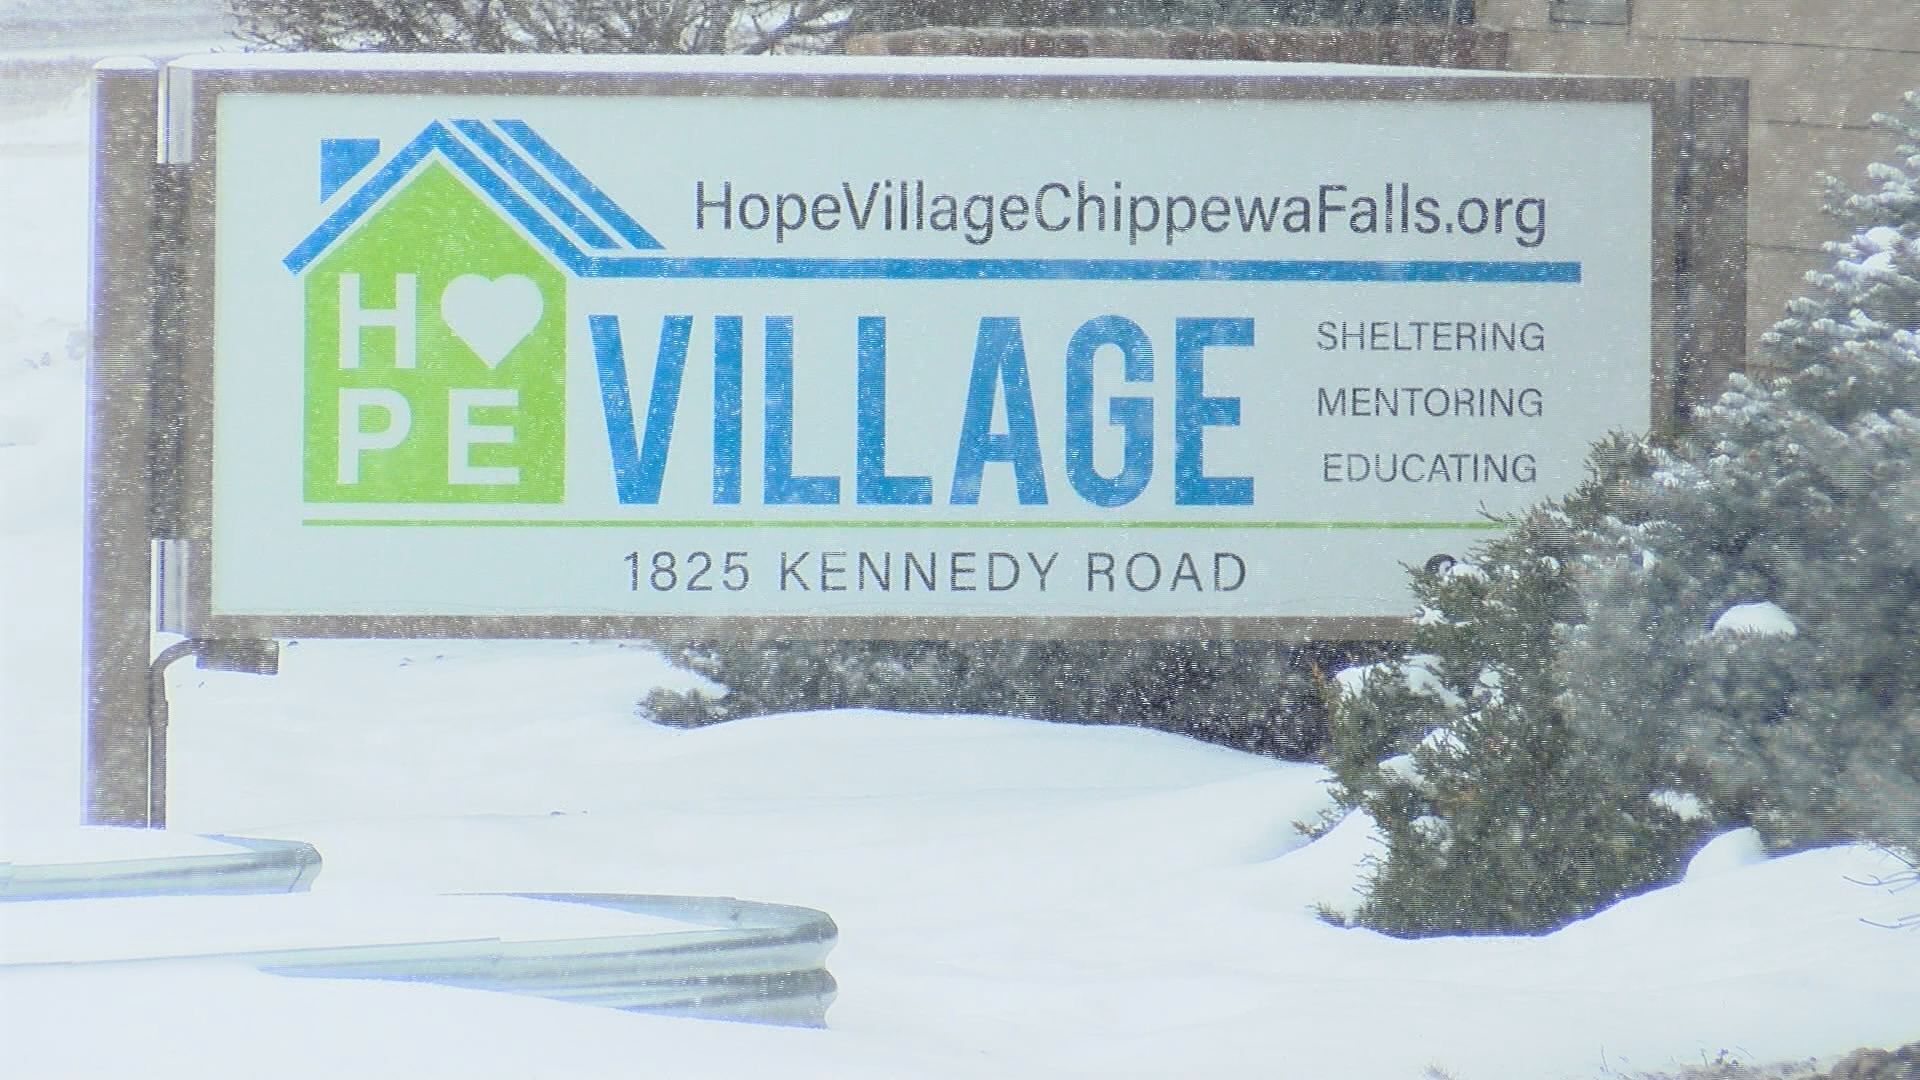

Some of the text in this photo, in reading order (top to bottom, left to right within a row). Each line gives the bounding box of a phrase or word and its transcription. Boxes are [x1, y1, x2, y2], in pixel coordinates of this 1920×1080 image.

[697, 180, 1546, 247] HopeVillageChippewaFalls.org
[1317, 321, 1545, 352] SHELTERING
[589, 315, 1255, 506] VILLAGE
[1318, 388, 1543, 418] MENTORING
[1324, 453, 1537, 483] EDUCATING
[625, 551, 1246, 592] 1825 KENNEDY ROAD
